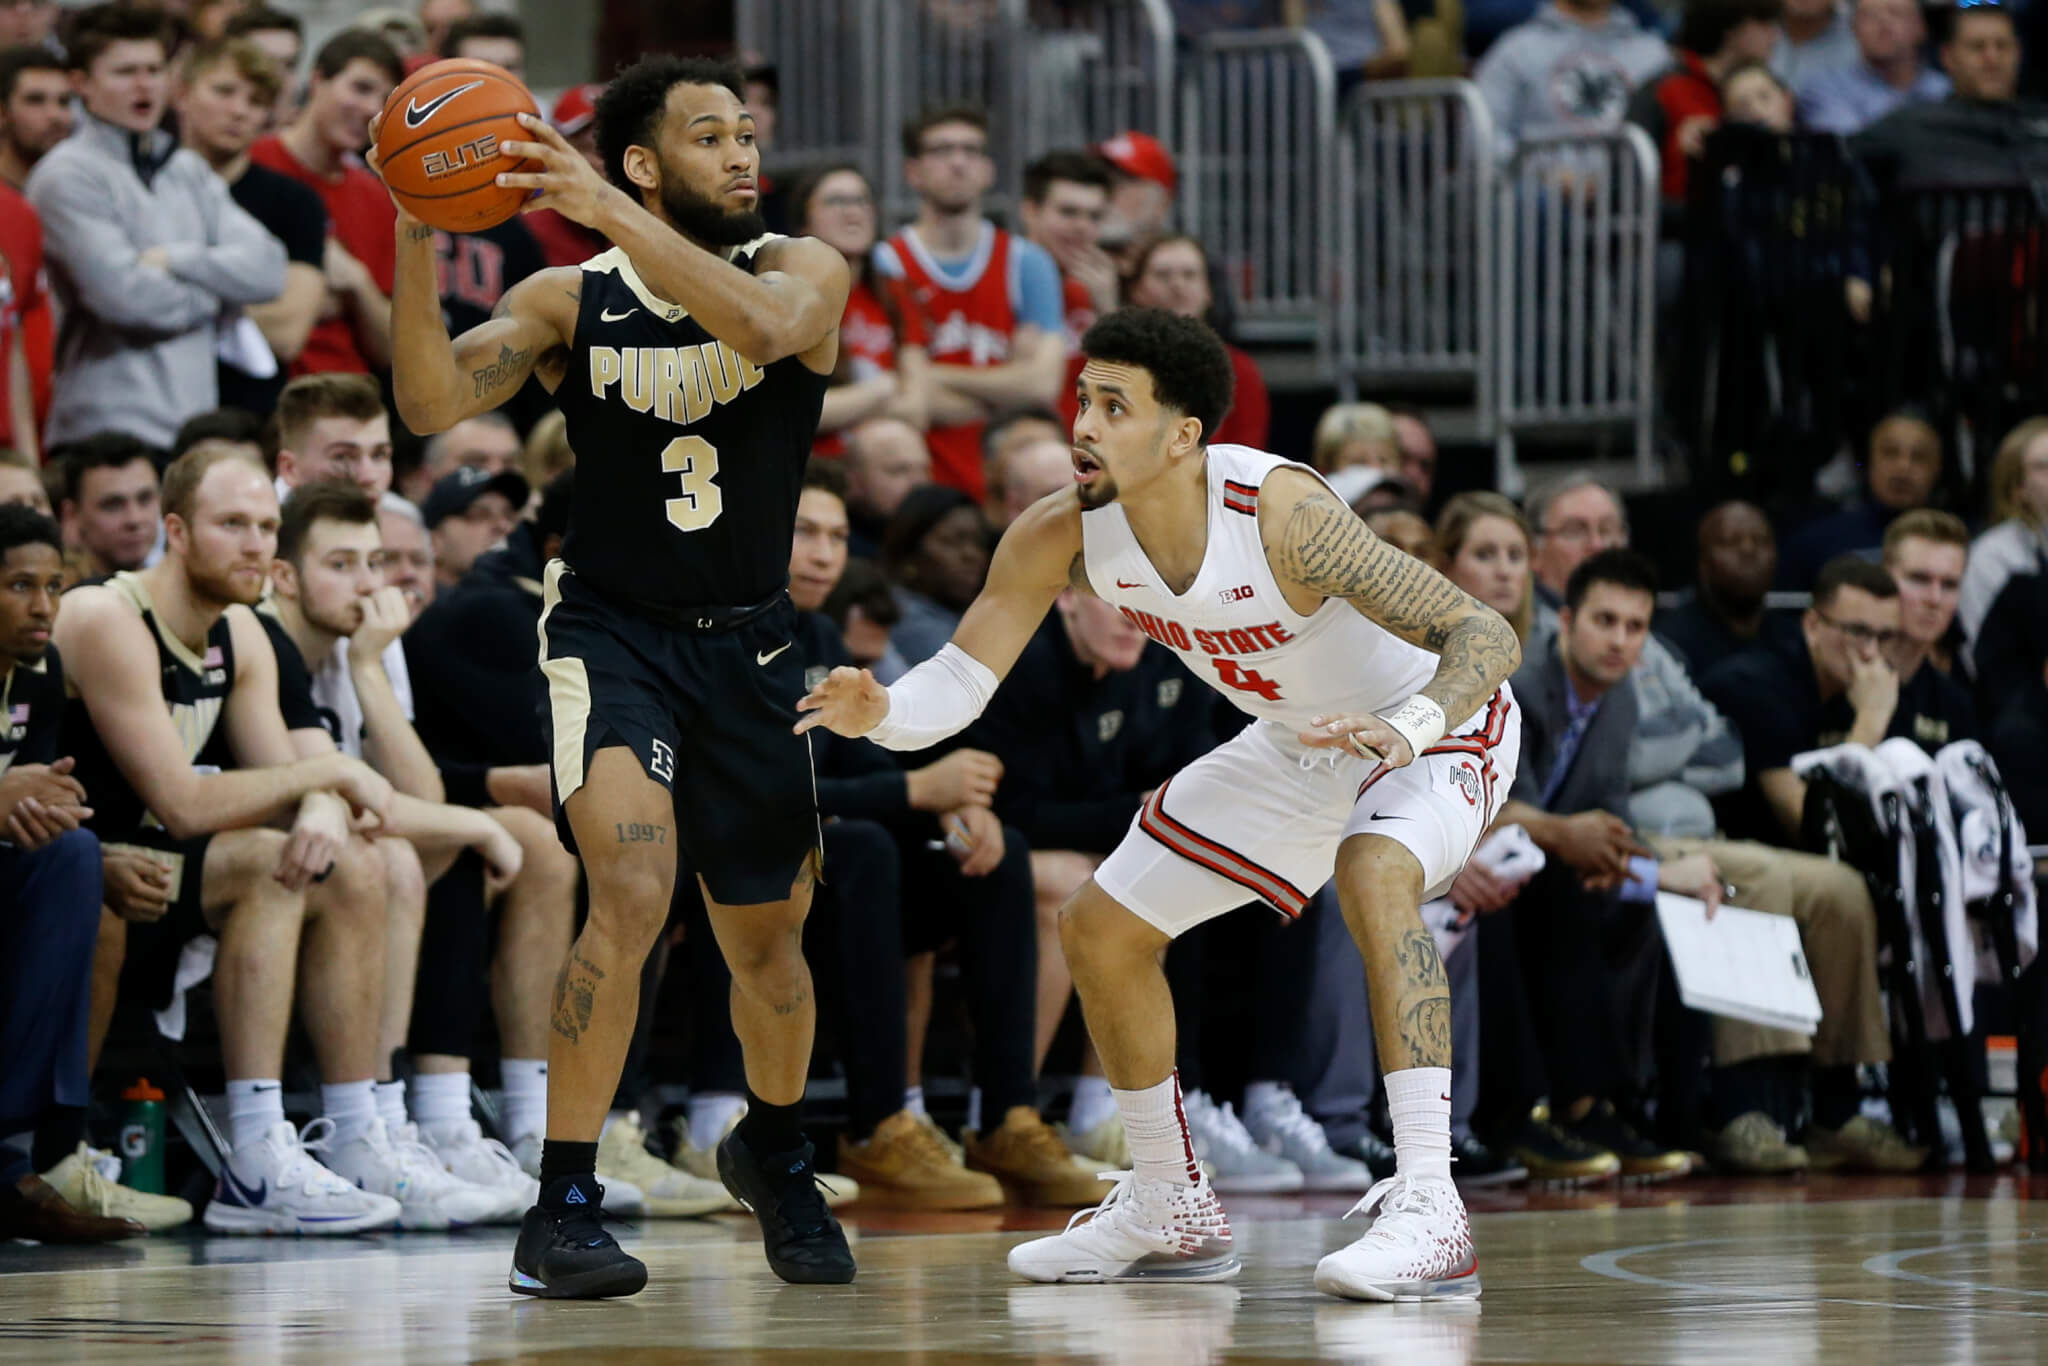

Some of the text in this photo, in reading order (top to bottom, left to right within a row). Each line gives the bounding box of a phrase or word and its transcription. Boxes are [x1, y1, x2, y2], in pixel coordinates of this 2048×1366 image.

[421, 133, 500, 177] ELITE
[661, 434, 723, 533] 3
[1192, 620, 1297, 656] STATE
[1212, 657, 1285, 701] 4
[616, 823, 667, 845] 1997
